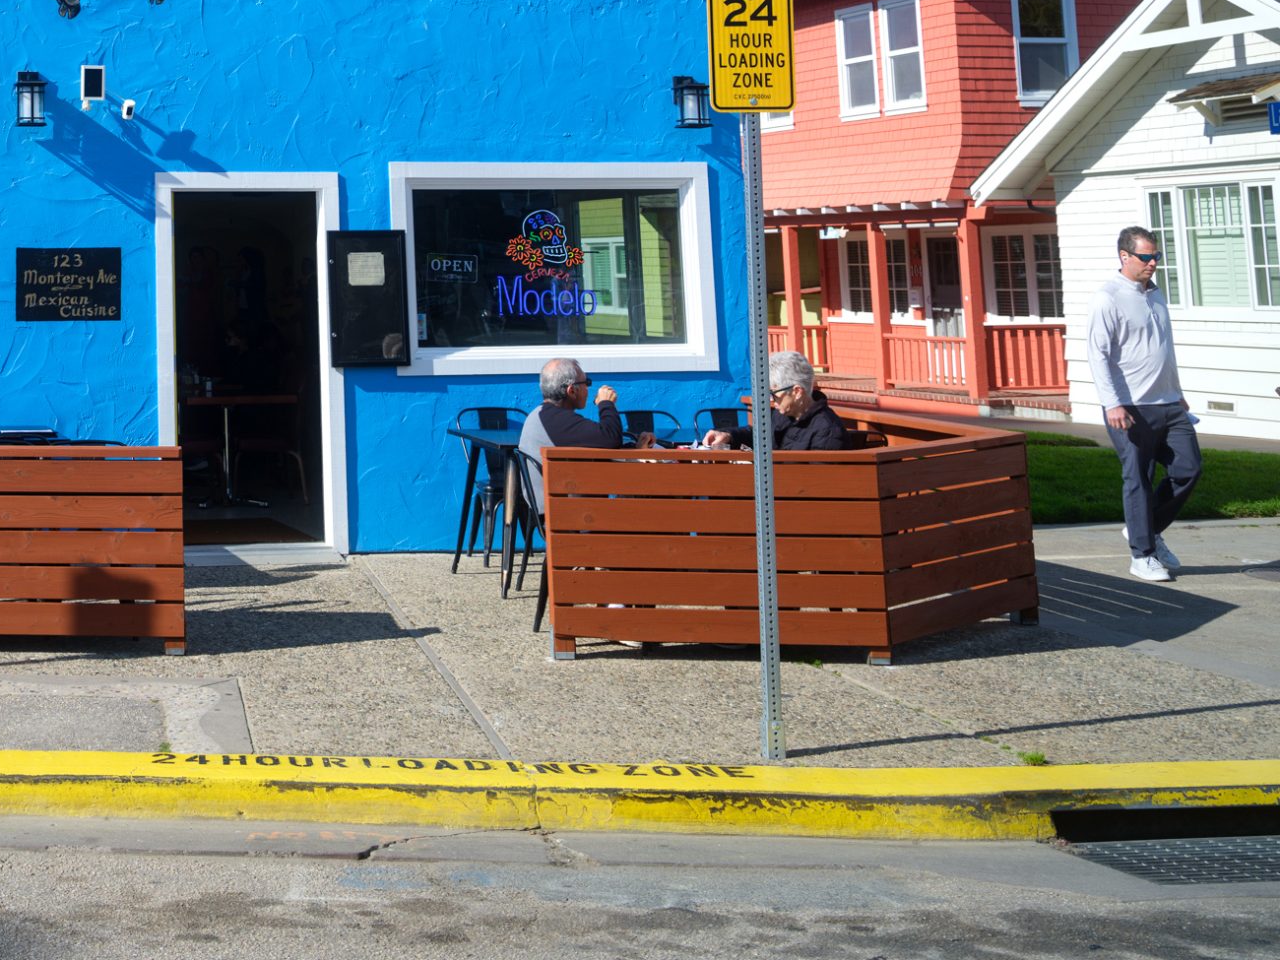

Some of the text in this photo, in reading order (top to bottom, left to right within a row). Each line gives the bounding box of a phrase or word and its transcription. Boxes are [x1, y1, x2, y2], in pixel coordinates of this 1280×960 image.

[730, 33, 773, 48] HOUR
[719, 52, 785, 68] LOADING
[732, 73, 773, 88] ZONE
[431, 258, 473, 272] OPEN
[23, 268, 117, 290] Monterey Ave
[525, 268, 570, 282] CERVEZA
[24, 292, 90, 308] Mexican
[497, 275, 597, 316] Modelo
[60, 304, 118, 318] Cuisine
[151, 753, 755, 778] 24 HOUR LOADING ZONE
